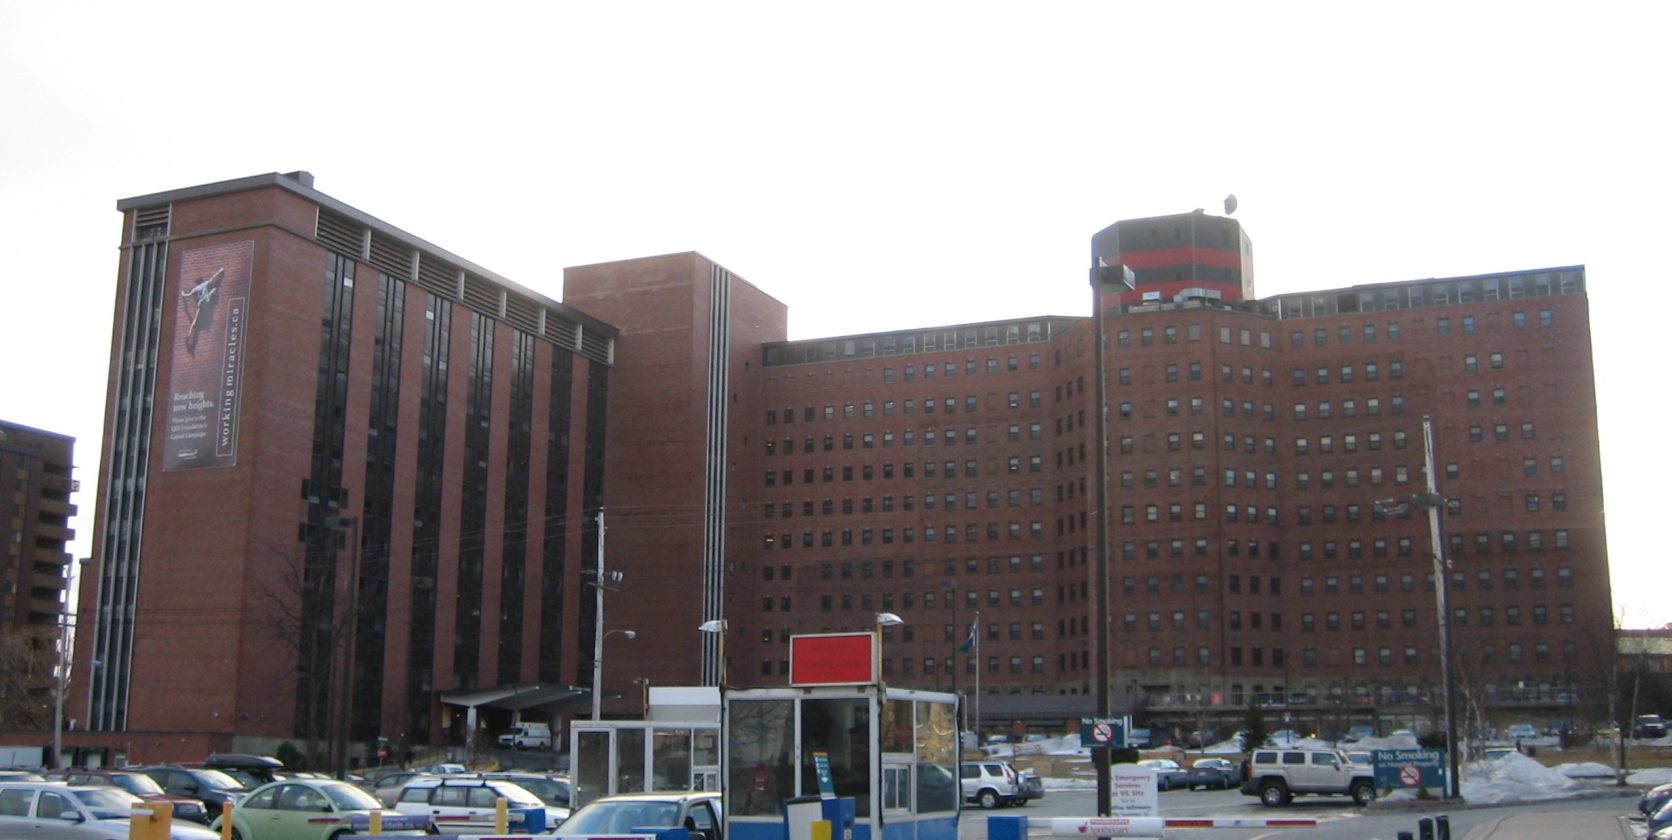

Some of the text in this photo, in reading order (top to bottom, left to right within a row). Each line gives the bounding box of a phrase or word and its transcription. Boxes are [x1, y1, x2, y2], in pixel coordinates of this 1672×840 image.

[222, 308, 240, 446] workingmiracles.ca
[173, 390, 205, 402] Reaching
[1378, 751, 1440, 762] No Smoking
